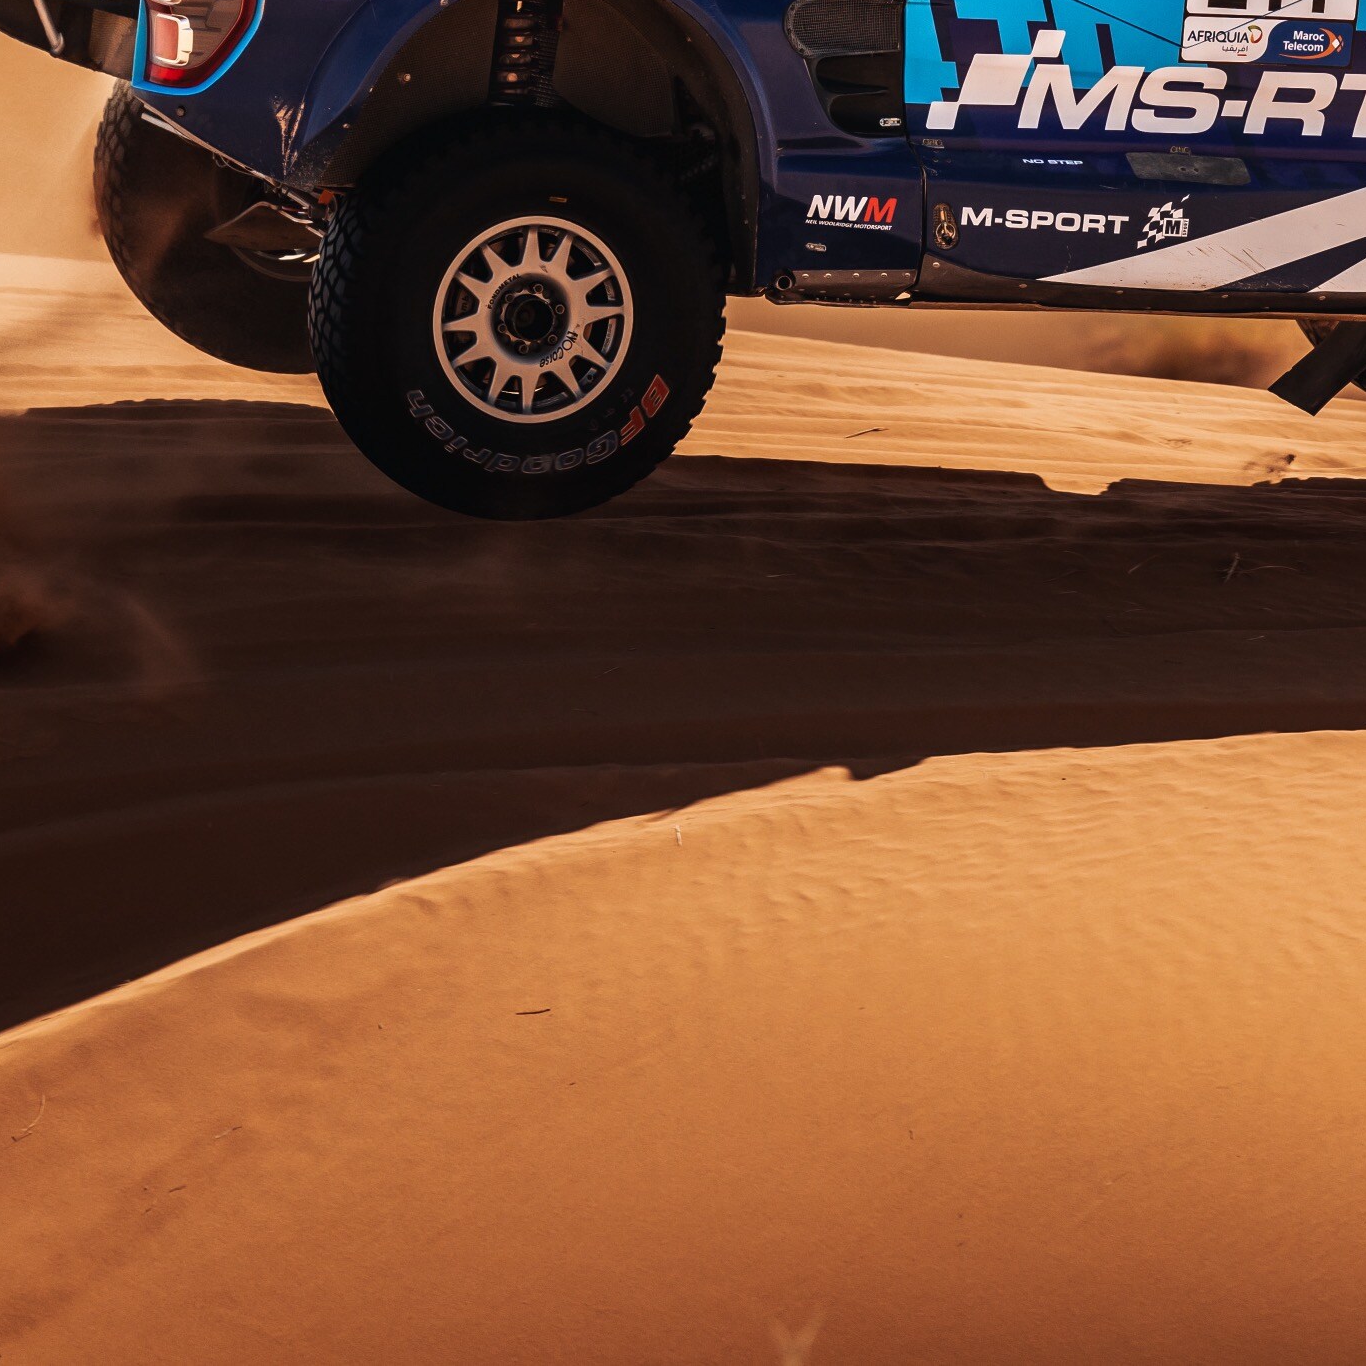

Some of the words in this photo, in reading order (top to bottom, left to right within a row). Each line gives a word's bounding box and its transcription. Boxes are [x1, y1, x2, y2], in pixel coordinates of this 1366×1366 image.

[1187, 30, 1250, 44] AFRIQUIA
[1293, 30, 1325, 42] Maroc
[1283, 40, 1324, 53] Telecom
[1047, 158, 1084, 166] STEP
[806, 194, 898, 224] NWM
[853, 223, 893, 231] MOTORSPORT
[960, 206, 1130, 234] M-SPORT
[487, 273, 522, 310] FONDMETAL
[406, 373, 671, 475] BFGoodrich
